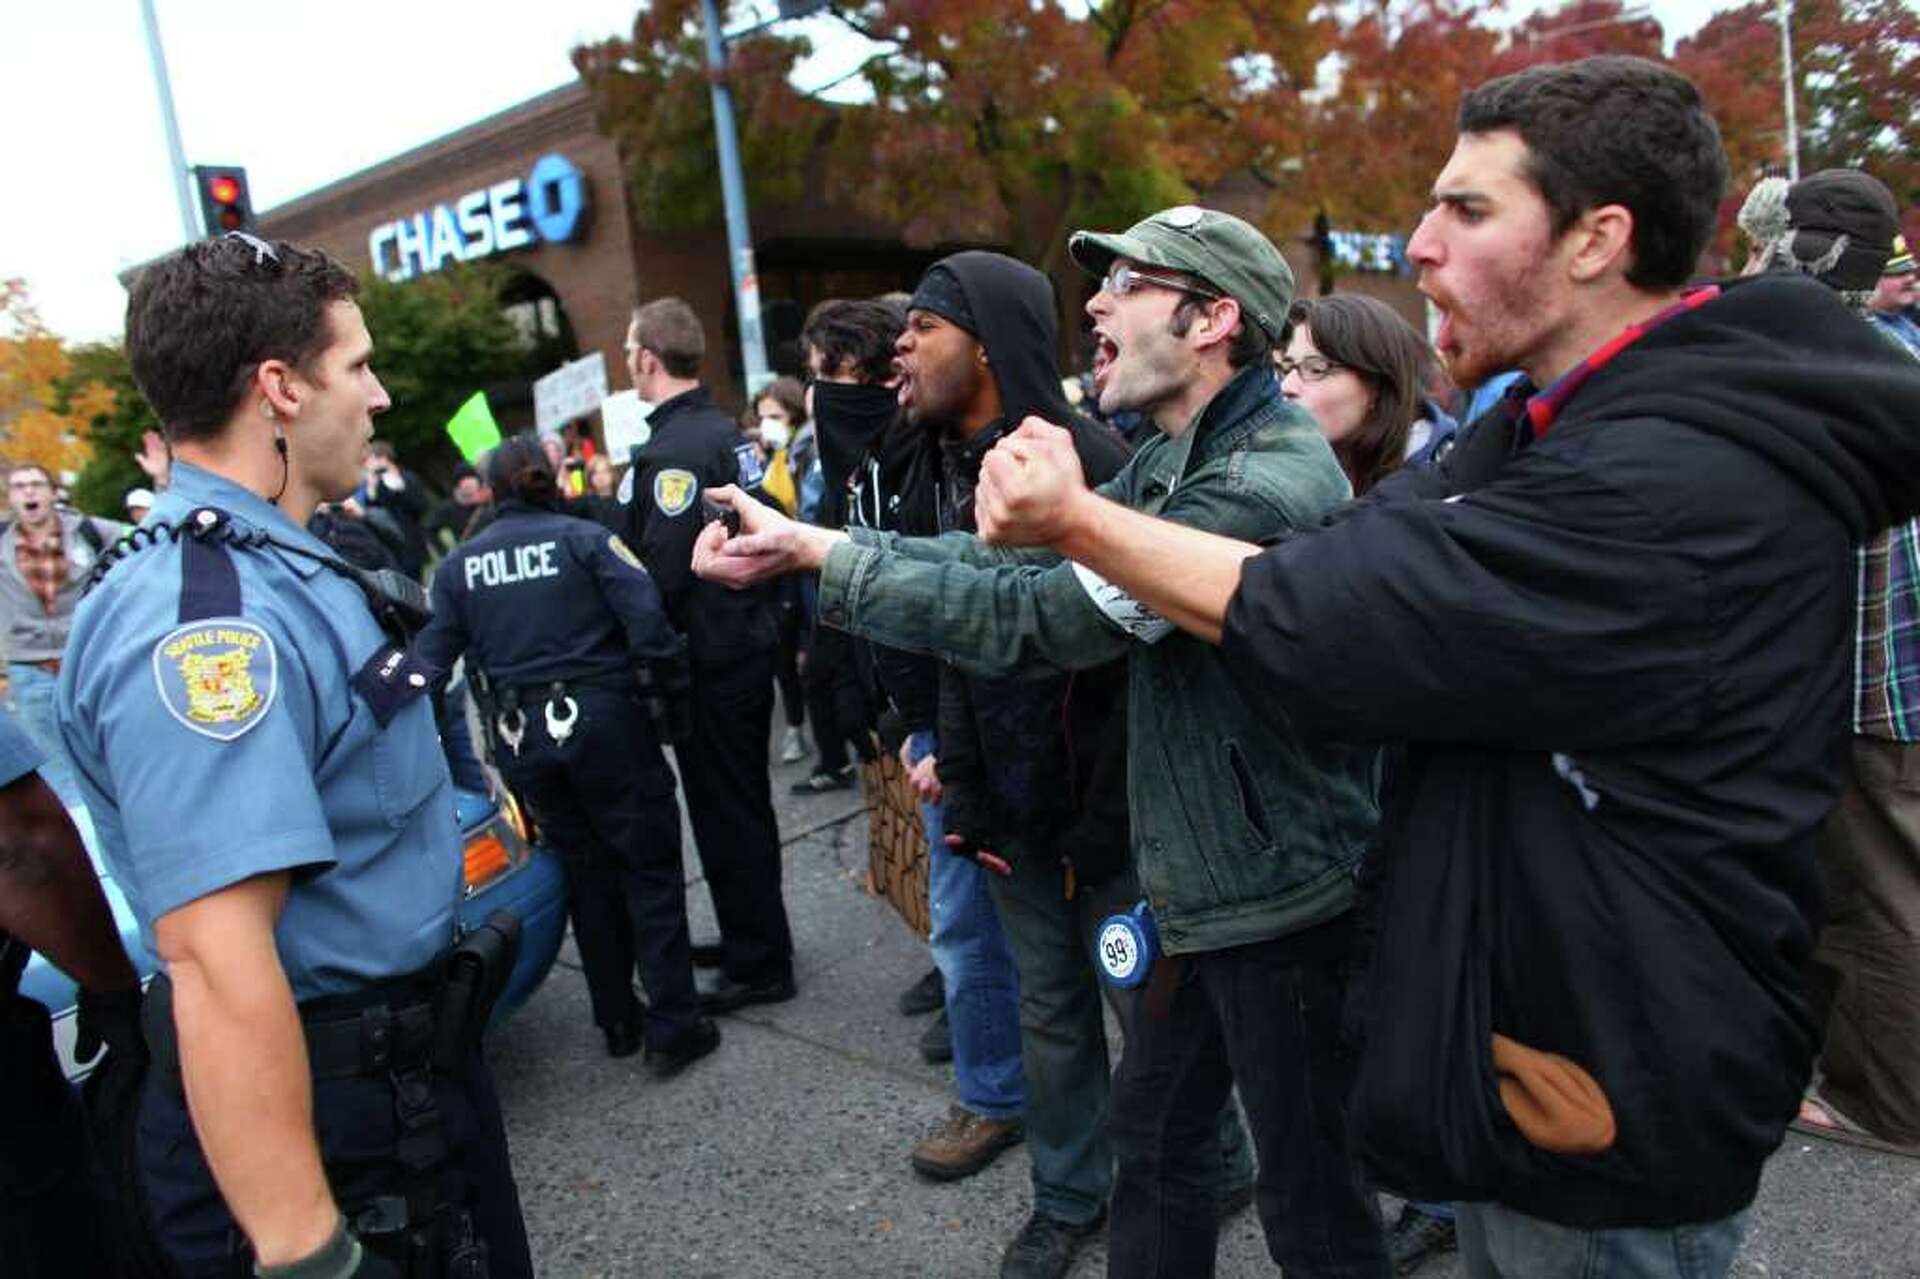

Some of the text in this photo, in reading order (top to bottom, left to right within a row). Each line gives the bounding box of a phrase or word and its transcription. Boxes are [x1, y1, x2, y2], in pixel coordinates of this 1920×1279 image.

[370, 179, 531, 282] CHASE
[465, 541, 558, 590] POLICE
[217, 629, 261, 649] POLICE
